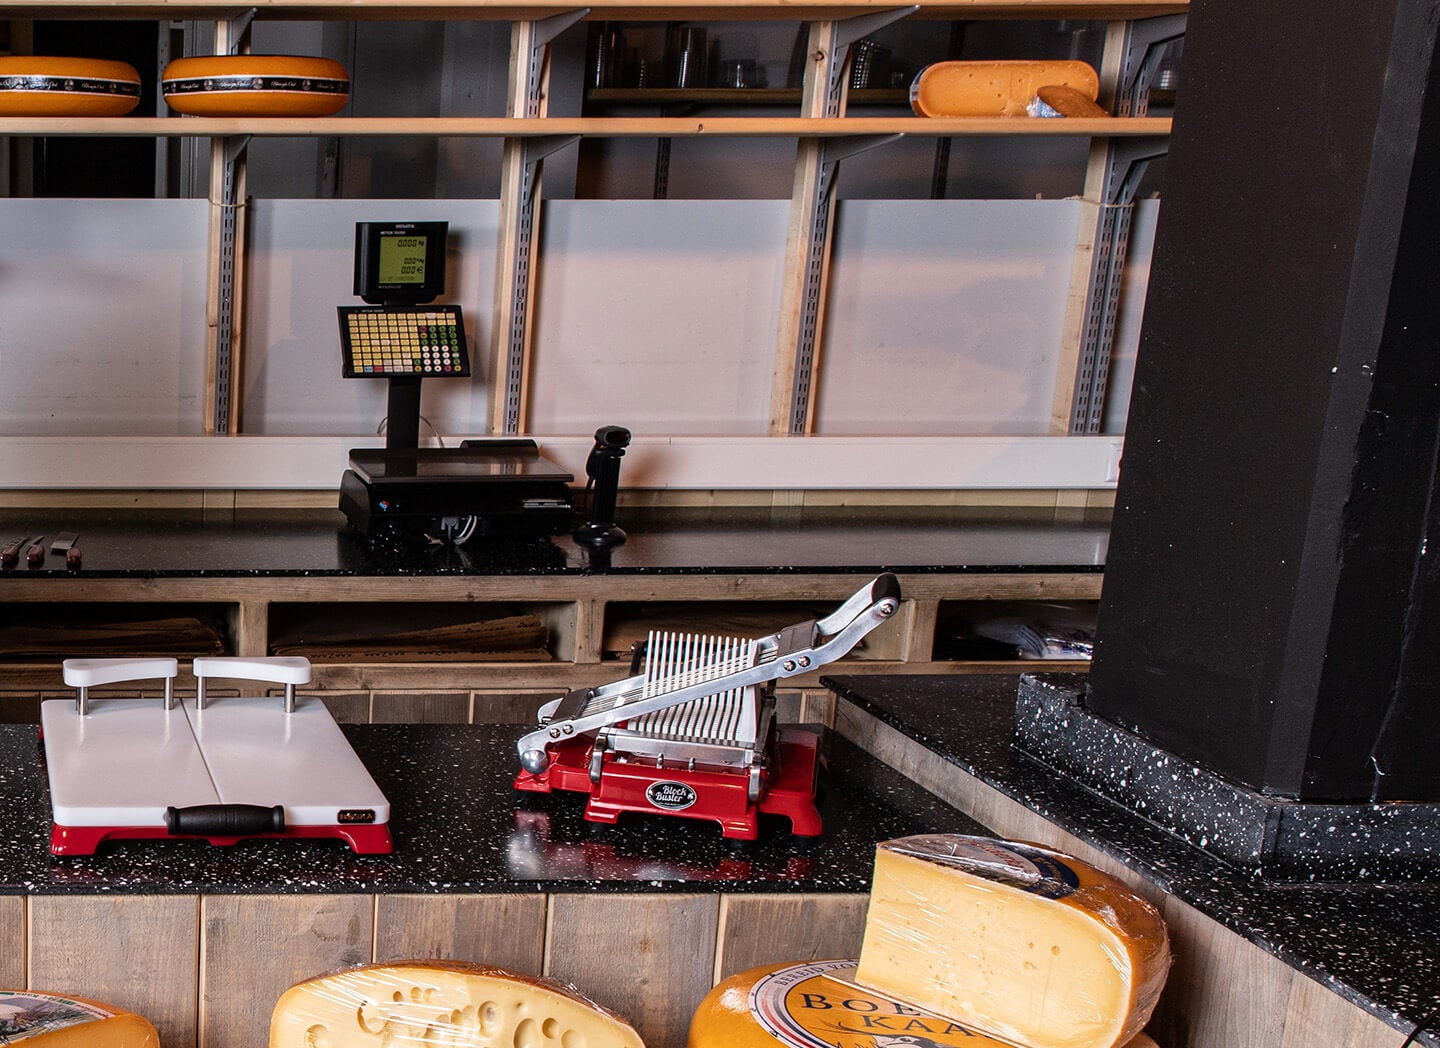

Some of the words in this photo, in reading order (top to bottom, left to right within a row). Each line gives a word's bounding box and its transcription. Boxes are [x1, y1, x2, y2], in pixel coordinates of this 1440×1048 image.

[655, 791, 683, 803] Buster
[663, 785, 687, 797] Block
[774, 966, 825, 987] BEREID
[799, 992, 921, 1017] BOE
[862, 1014, 977, 1038] KAA
